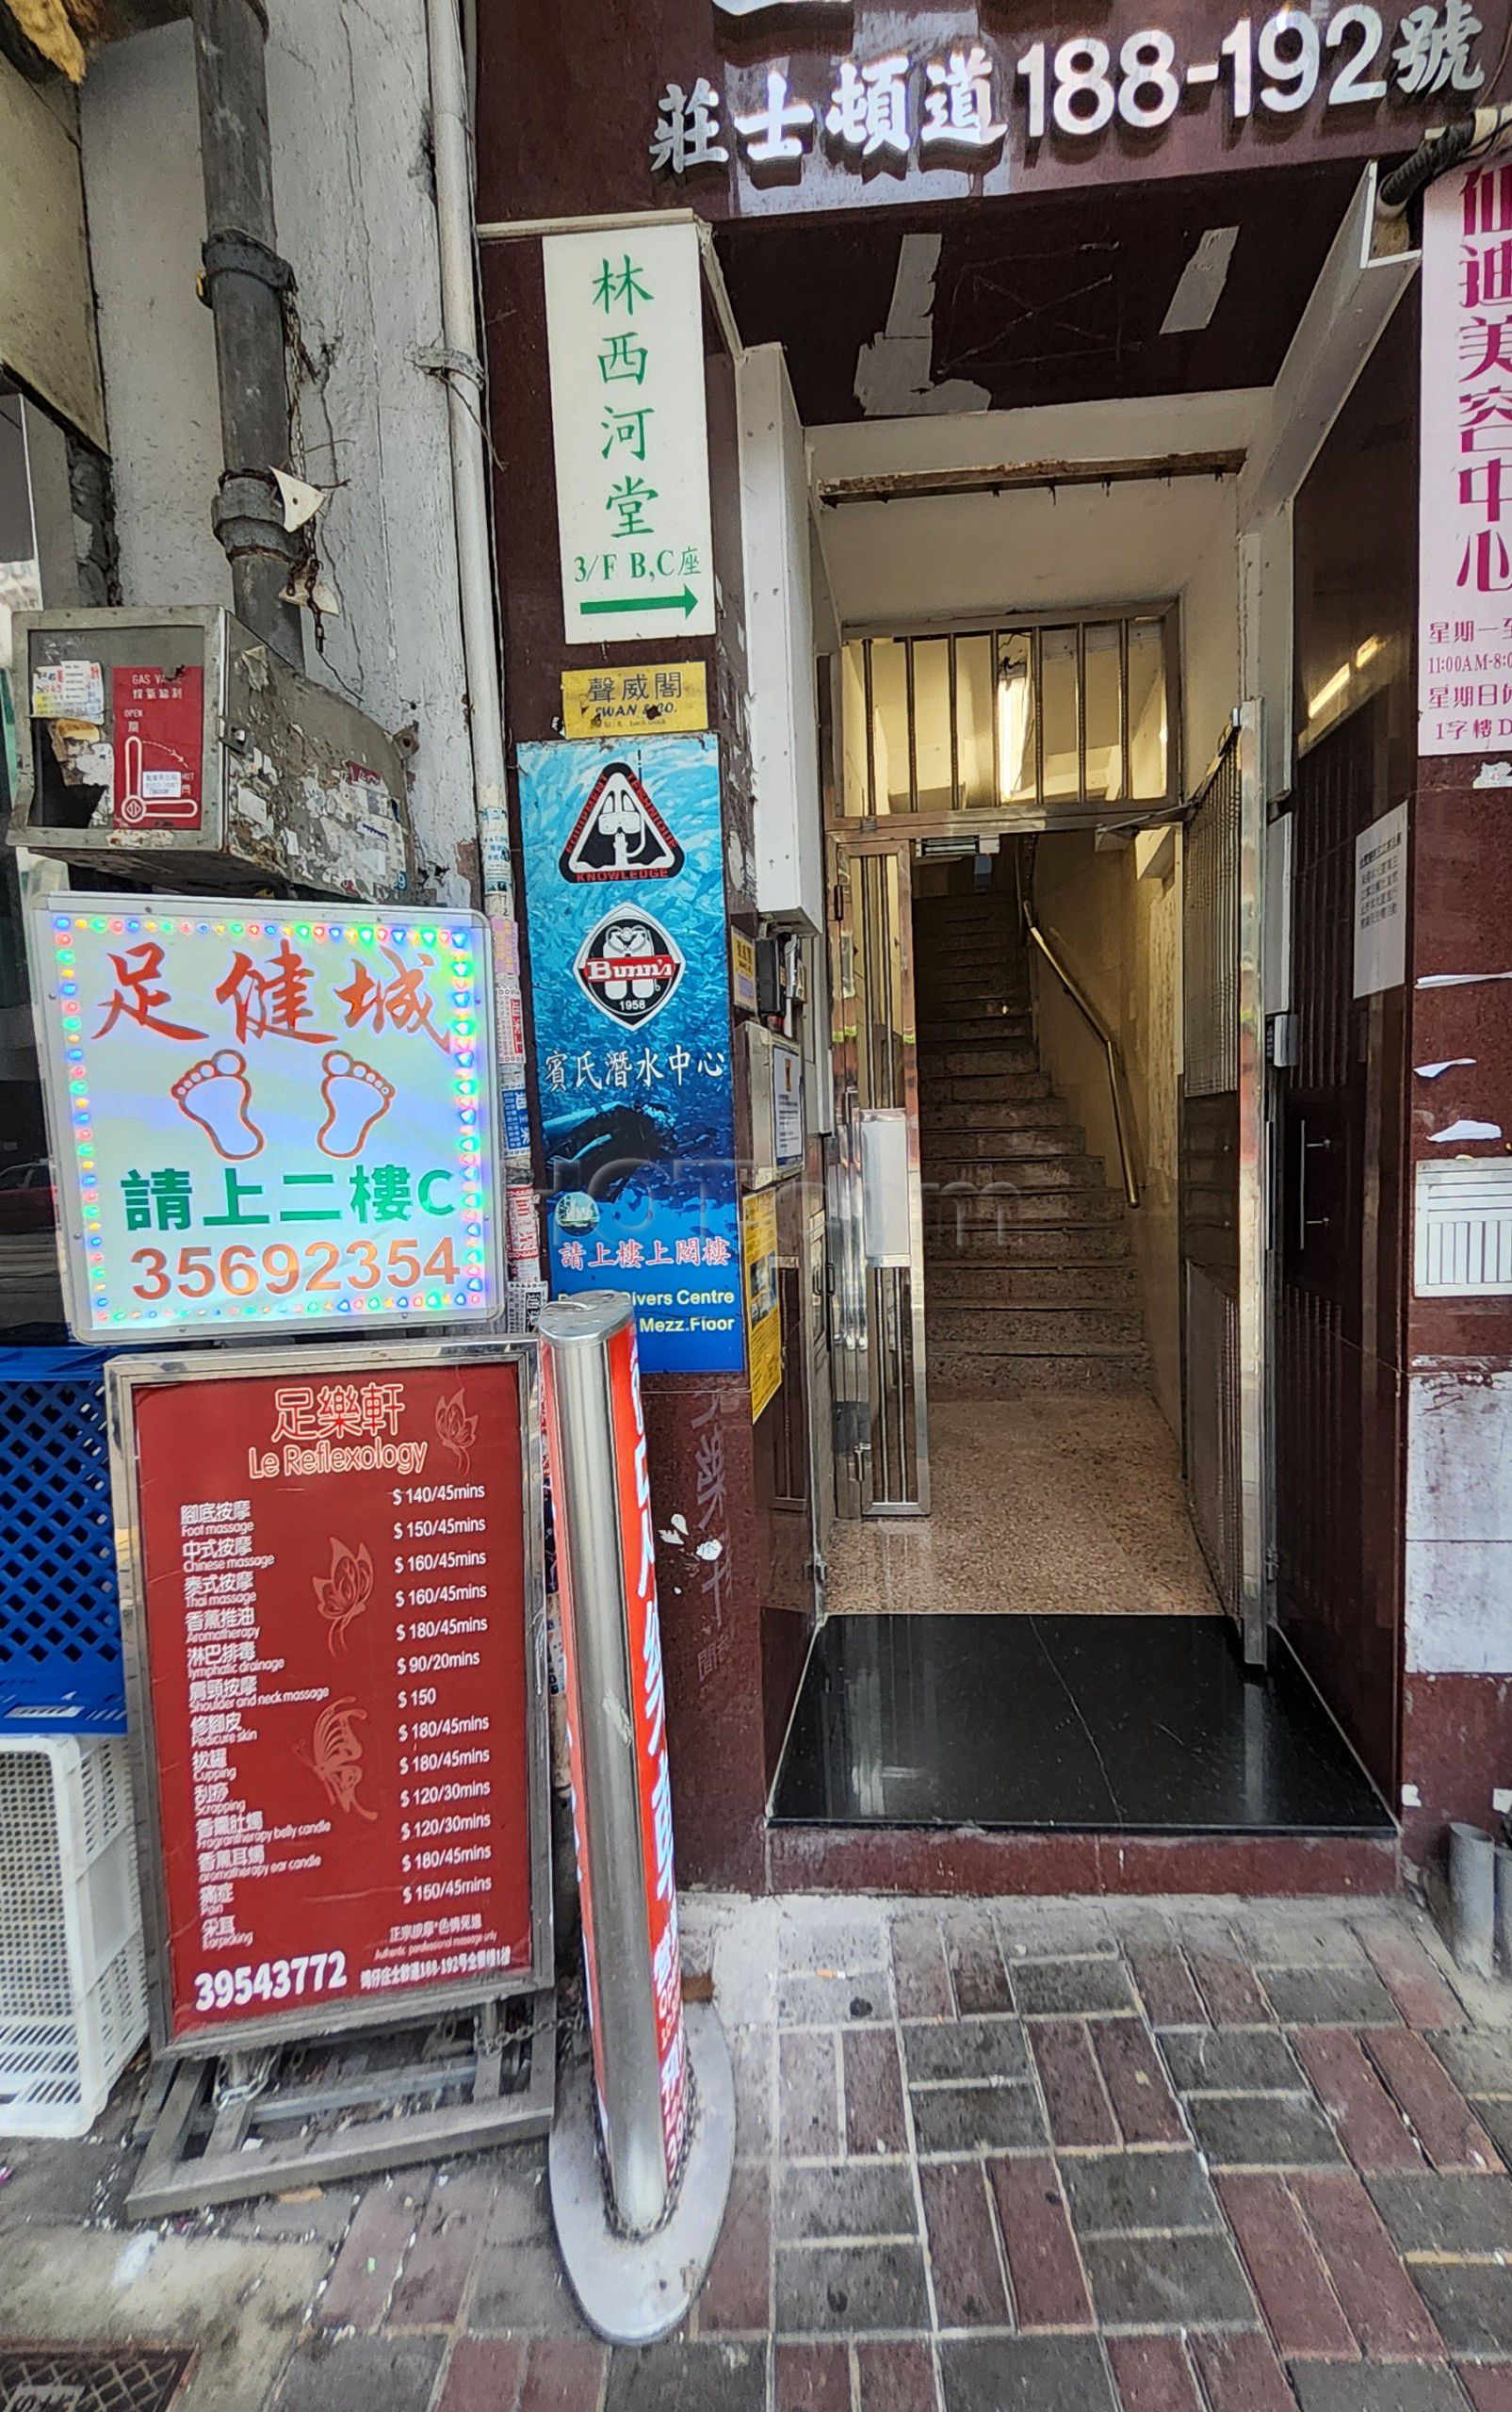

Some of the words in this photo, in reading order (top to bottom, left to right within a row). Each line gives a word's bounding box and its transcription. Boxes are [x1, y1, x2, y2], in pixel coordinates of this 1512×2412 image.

[592, 253, 658, 539] 林西河堂
[574, 554, 617, 582] 3/F
[132, 674, 151, 685] GAS
[588, 672, 683, 703] 聲威閣
[576, 869, 669, 882] KNOWLEDGE
[586, 957, 673, 981] Bunn's
[91, 938, 453, 1052] 足健城
[619, 1000, 645, 1011] 1958
[544, 1045, 725, 1092] 賓氏潛水中心
[131, 1236, 461, 1300] 35692354
[676, 1290, 735, 1306] Centre
[271, 1381, 405, 1443] 足樂軒
[249, 1445, 281, 1479] Le
[285, 1436, 428, 1477] Reflexology
[406, 1483, 485, 1504] 140/45mins
[206, 1522, 254, 1536] massage
[406, 1516, 486, 1538] 150/45mins
[183, 1536, 252, 1561] 中式按摩
[183, 1559, 225, 1573] Chinese
[227, 1556, 274, 1570] massage
[407, 1550, 486, 1572] 160/45mins
[209, 1592, 256, 1606] massage
[408, 1584, 487, 1605] 160/45mins
[409, 1617, 488, 1639] 180/45mins
[409, 1650, 480, 1673] 90/20mins
[236, 1693, 256, 1707] and
[283, 1687, 329, 1703] massage
[411, 1687, 436, 1707] 150
[194, 1950, 347, 2012] 39543772
